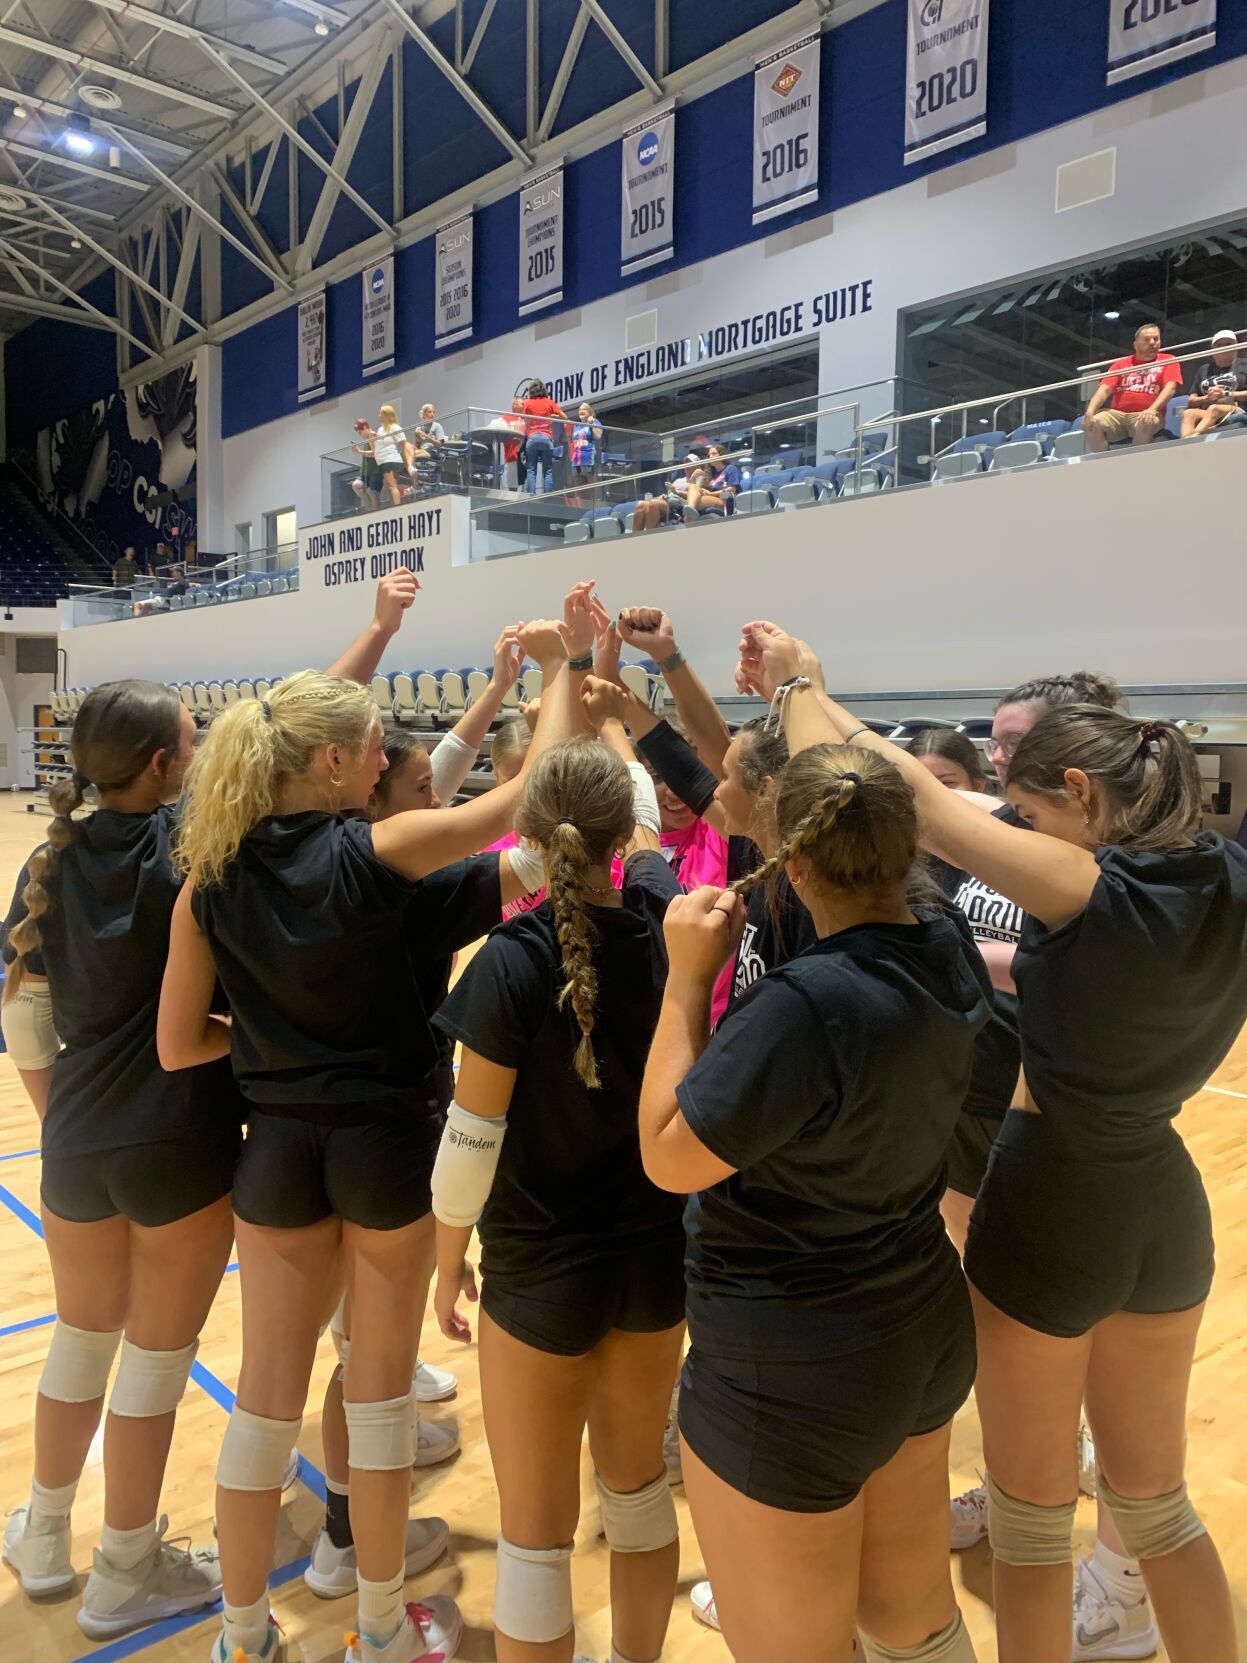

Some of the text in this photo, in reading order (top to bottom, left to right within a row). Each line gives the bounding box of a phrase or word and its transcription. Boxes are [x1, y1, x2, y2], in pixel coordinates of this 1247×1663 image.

[916, 14, 980, 56] TOURNAMENT
[915, 57, 978, 120] 2020
[761, 94, 812, 129] TOURNAMENT
[639, 143, 658, 161] NCAA
[761, 132, 809, 184] 2016
[628, 162, 668, 191] TOURNAMENT
[524, 186, 561, 216] ASUN
[630, 196, 665, 239] 2015
[438, 231, 471, 257] ASUN
[527, 245, 556, 283] 2015
[440, 283, 469, 307] 2015 2016
[446, 303, 461, 320] 2020
[371, 320, 385, 337] 2016
[371, 335, 385, 351] 2020
[590, 363, 608, 394] OF
[614, 337, 691, 387] ENGLAND
[697, 301, 803, 362] MORTGAGE
[812, 279, 873, 328] SUITE
[305, 508, 442, 560] JOHN AND GERRI HAYT
[324, 546, 424, 587] OSPREY OUTLOOK
[449, 1125, 496, 1149] Tandem
